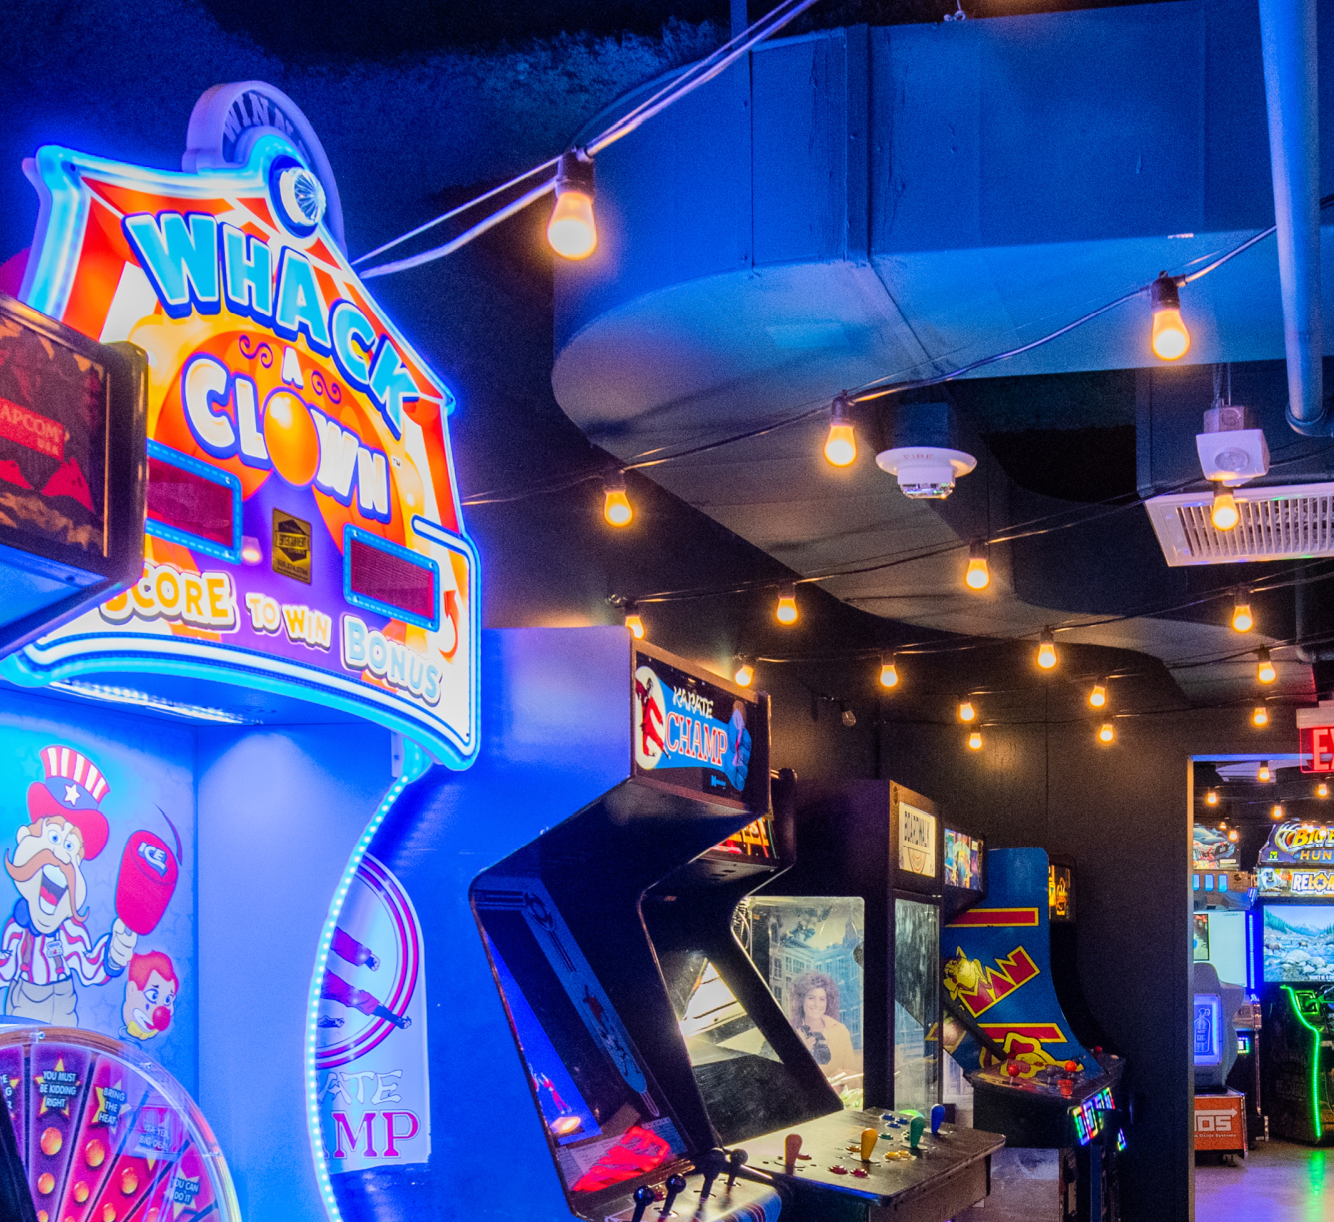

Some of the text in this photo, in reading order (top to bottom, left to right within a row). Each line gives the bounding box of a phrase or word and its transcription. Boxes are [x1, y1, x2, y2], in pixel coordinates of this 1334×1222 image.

[124, 212, 420, 439] WHACK
[281, 346, 304, 386] A
[181, 352, 391, 523] CLOWN
[247, 593, 281, 633] TO
[284, 606, 331, 652] WIN
[343, 616, 442, 705] BONUS
[672, 686, 714, 720] KARATE
[666, 710, 728, 767] CHAMP
[1292, 828, 1327, 848] BIG
[138, 842, 169, 877] ICE
[42, 1070, 76, 1082] YOU MUST
[39, 1083, 77, 1095] BE KIDDING
[102, 1087, 126, 1101] BRING
[318, 1068, 405, 1106] ATE
[45, 1097, 66, 1107] RIGHT
[105, 1101, 118, 1112] THE
[98, 1111, 118, 1125] HEAT
[1194, 1115, 1232, 1132] OS
[323, 1109, 420, 1159] MP
[174, 1191, 192, 1203] DO IT
[185, 1182, 199, 1193] CAN
